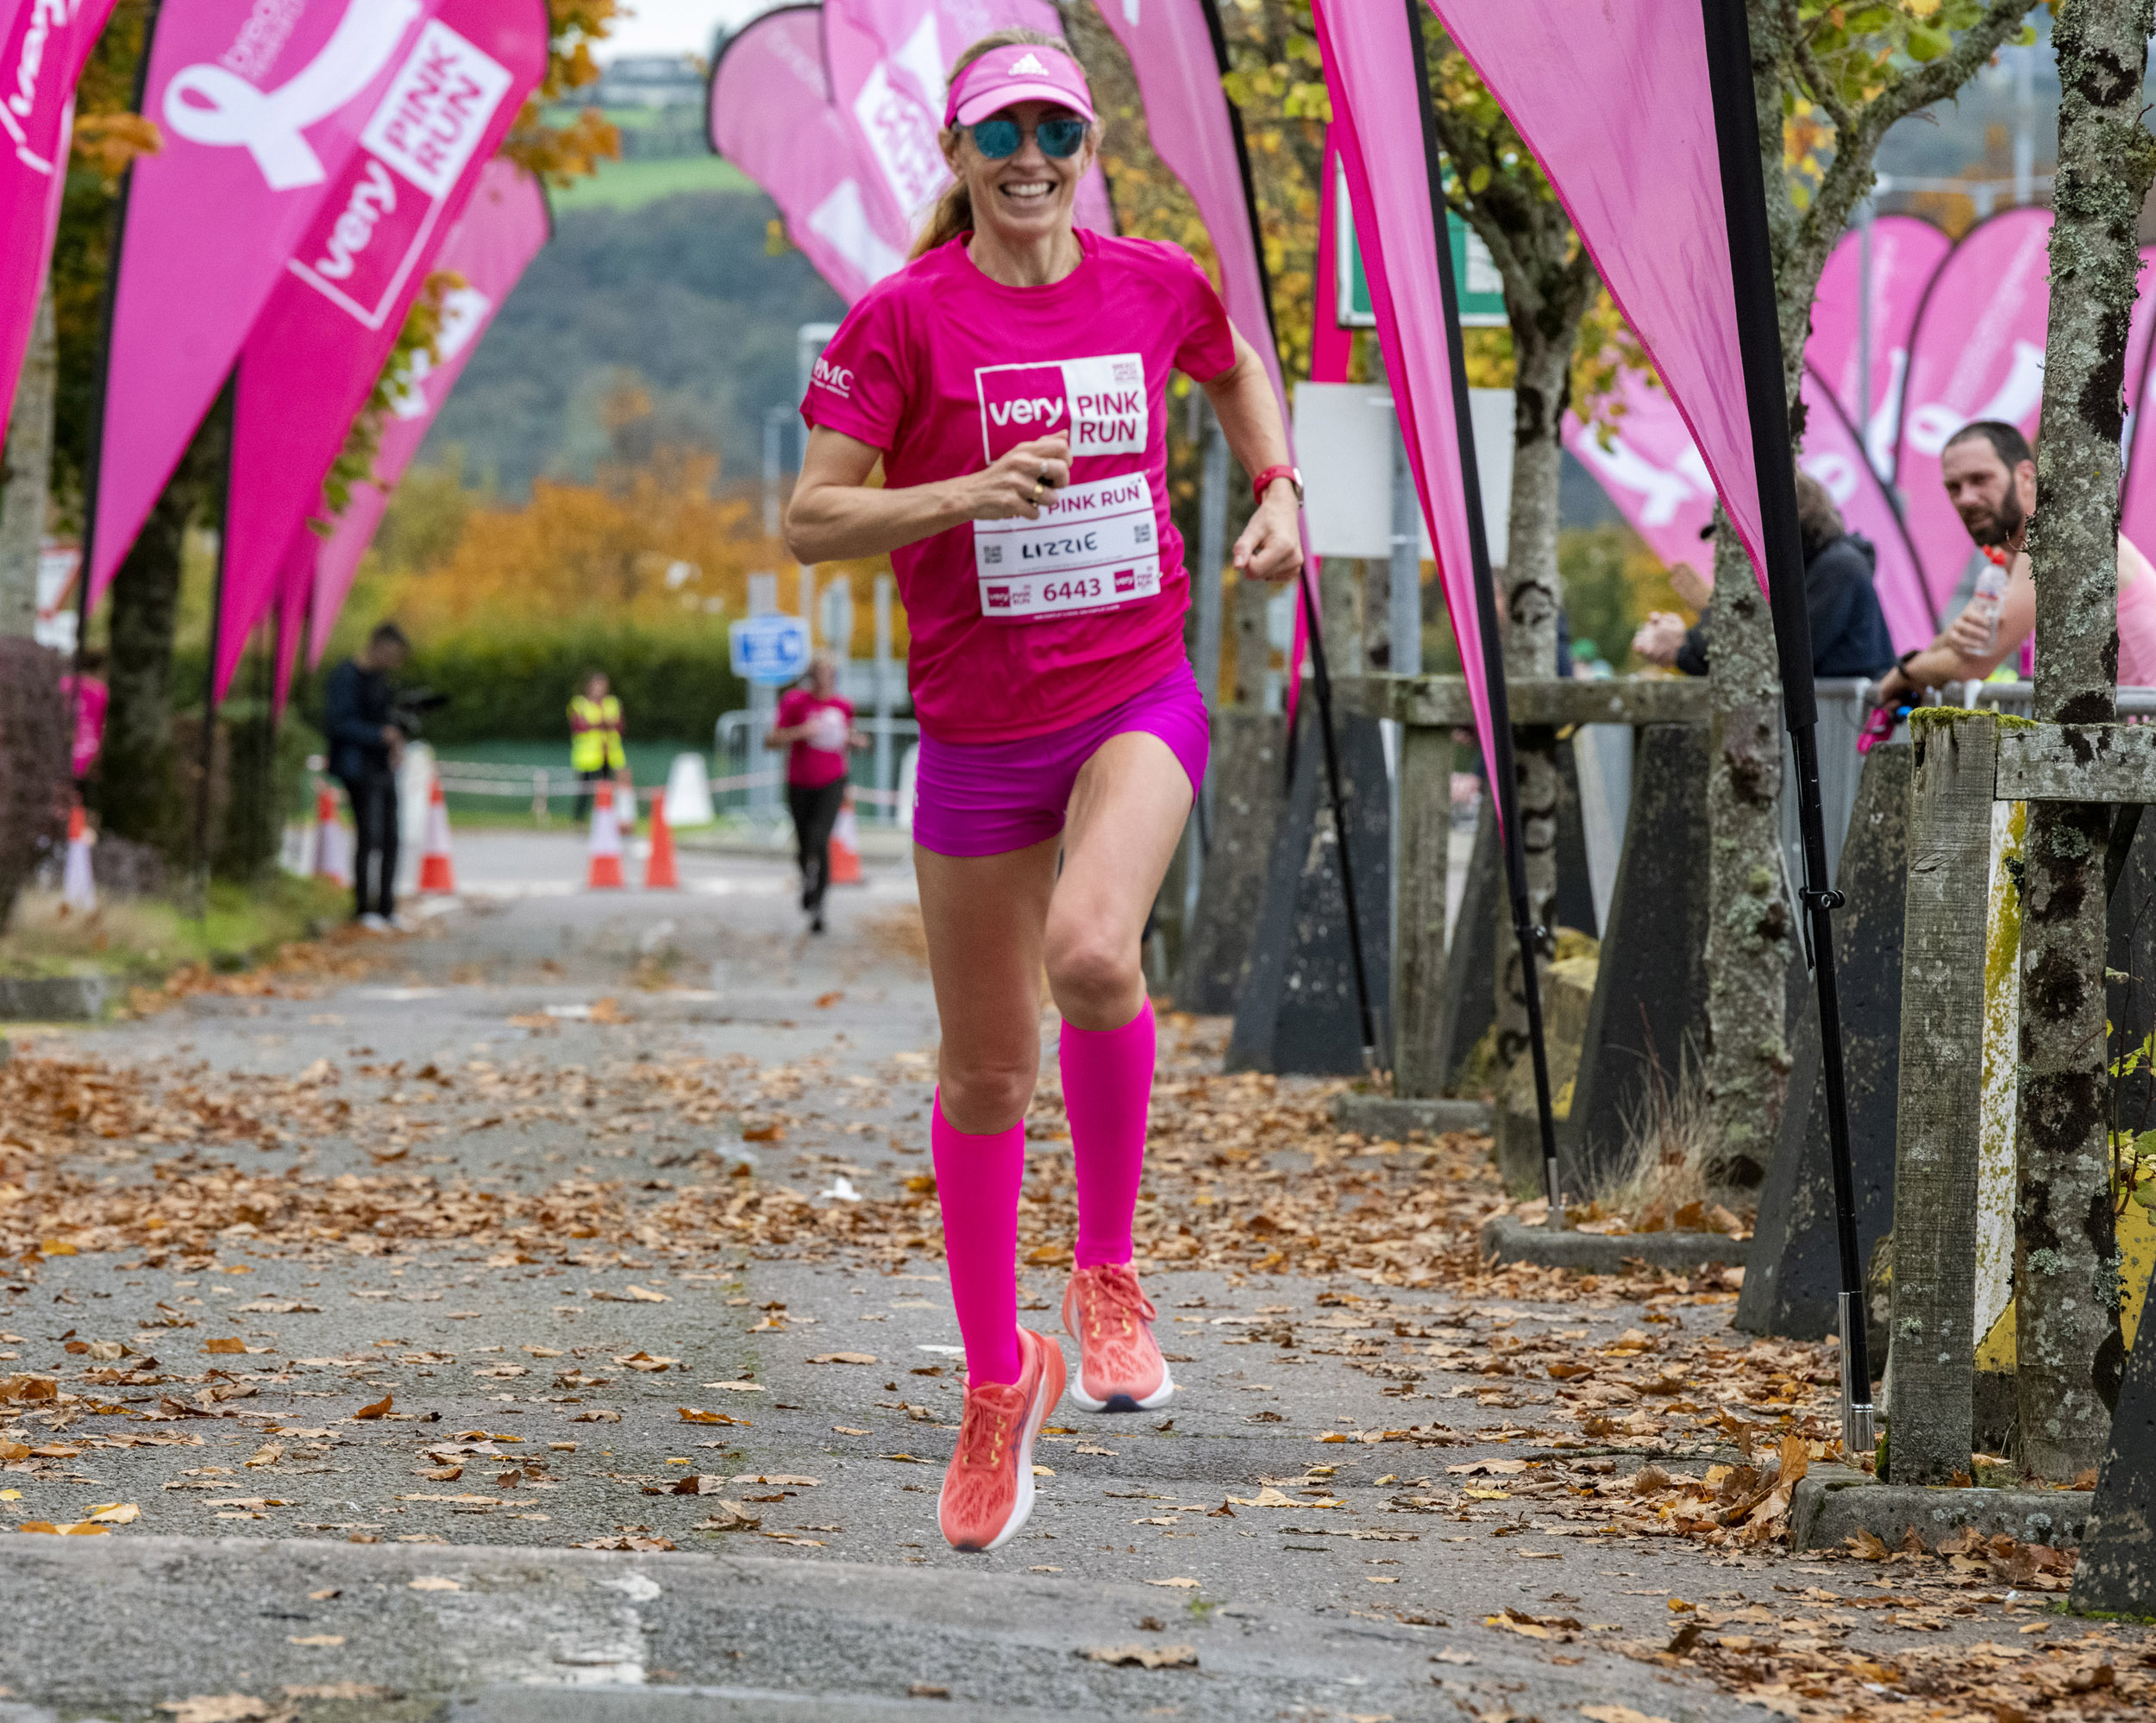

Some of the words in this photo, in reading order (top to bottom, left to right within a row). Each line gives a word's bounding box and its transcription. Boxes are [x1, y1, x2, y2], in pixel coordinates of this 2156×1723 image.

[384, 40, 461, 154] PINK
[414, 72, 483, 177] RUN
[315, 159, 398, 279] very
[988, 396, 1063, 429] very
[1076, 391, 1140, 417] PINK
[1080, 418, 1137, 444] RUN
[1048, 493, 1096, 515] PINK
[1100, 485, 1140, 507] RUN
[1022, 530, 1099, 559] LIZZIE
[1044, 578, 1101, 602] 6443
